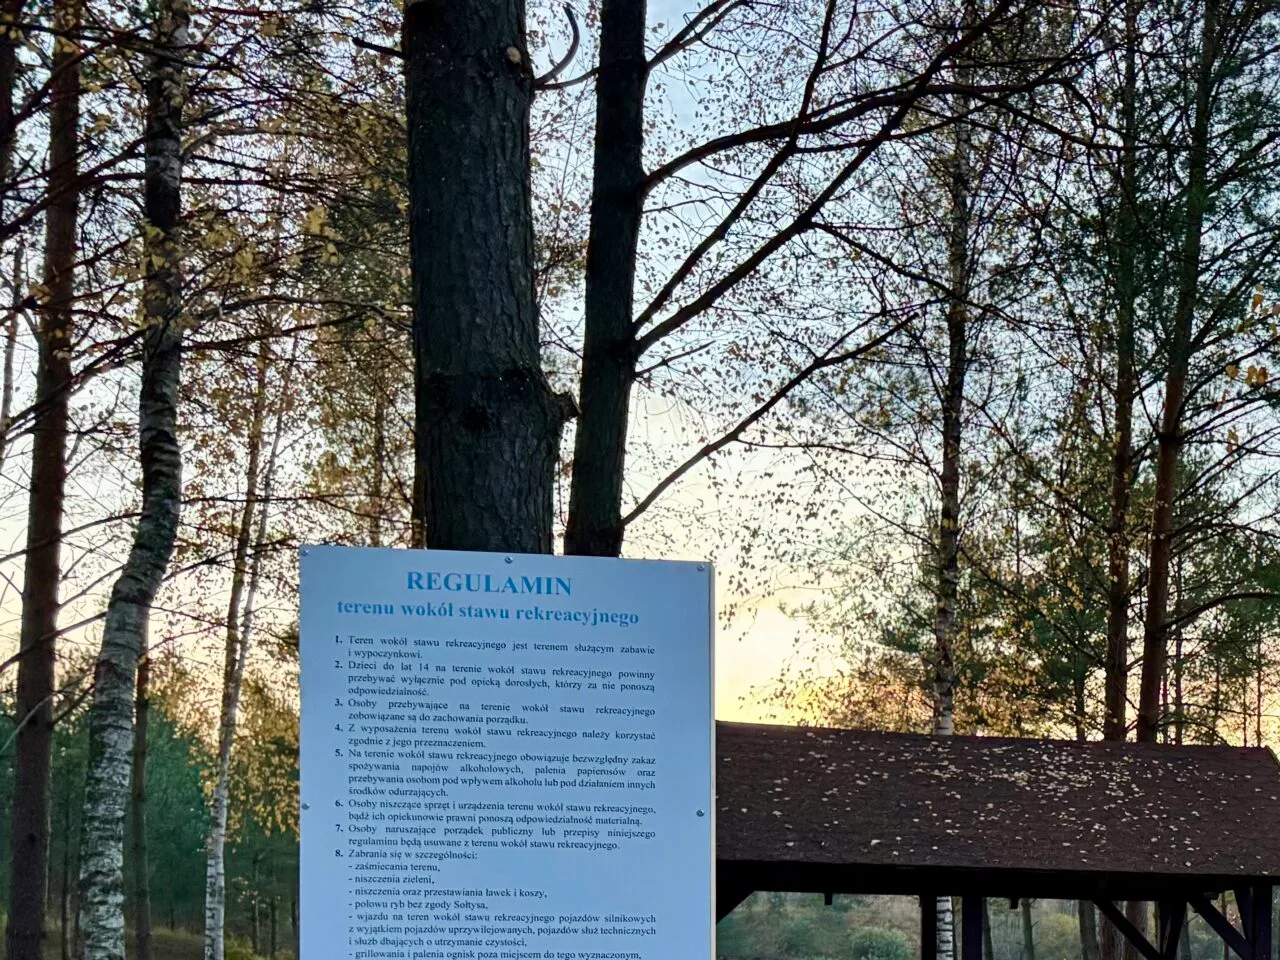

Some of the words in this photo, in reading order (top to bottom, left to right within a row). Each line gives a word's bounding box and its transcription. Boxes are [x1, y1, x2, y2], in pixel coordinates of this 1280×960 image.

[406, 571, 572, 596] REGULAMIN
[337, 600, 394, 615] terenu
[401, 602, 453, 617] wokół
[458, 605, 510, 620] stawu
[516, 606, 639, 627] rekreacyjnego
[335, 634, 343, 643] 1.
[347, 635, 373, 644] Teren
[379, 636, 407, 645] wokół
[413, 638, 439, 646] stawu
[445, 638, 506, 650] rekreacyjnego
[512, 641, 527, 651] jest
[533, 642, 568, 650] terenem
[574, 643, 614, 654] służącym
[620, 644, 655, 653] zabawie
[353, 648, 422, 660] wypoczynkowi.
[334, 660, 343, 668] 2.
[348, 660, 377, 669] Dzieci
[382, 661, 395, 669] do
[400, 662, 412, 670] lat
[419, 662, 429, 670] 14
[452, 663, 482, 672] terenie
[487, 664, 514, 673] wokół
[552, 667, 612, 678] rekreacyjnego
[618, 669, 655, 680] powinny
[347, 672, 396, 684] przebywać
[400, 674, 445, 685] wyłącznie
[449, 676, 466, 686] pod
[471, 676, 500, 687] opieką
[554, 679, 583, 690] którzy
[601, 680, 615, 689] nie
[620, 683, 655, 692] ponoszą
[347, 685, 429, 697] odpowiedzialność.
[334, 722, 343, 730] 4.
[360, 723, 417, 734] wyposażenia
[453, 725, 481, 734] wokół
[486, 727, 512, 735] stawu
[516, 727, 577, 739] rekreacyjnego
[581, 729, 610, 739] należy
[615, 730, 655, 741] korzystać
[347, 735, 383, 746] zgodnie
[392, 736, 412, 747] jego
[413, 737, 486, 749] przeznaczeniem.
[334, 798, 343, 806] 6.
[347, 798, 378, 809] Osoby
[379, 799, 421, 809] niszczące
[423, 800, 450, 810] sprzęt
[457, 800, 505, 810] urządzenia
[536, 802, 563, 810] wokół
[565, 803, 591, 811] stawu
[348, 810, 370, 820] bądź
[371, 811, 385, 819] ich
[387, 811, 443, 822] opiekunowie
[445, 812, 476, 823] prawni
[478, 815, 514, 823] ponoszą
[515, 814, 593, 825] odpowiedzialność
[595, 815, 643, 825] materialną.
[334, 848, 343, 856] 8.
[348, 848, 387, 857] Zabrania
[389, 849, 402, 858] się
[354, 861, 408, 869] zaśmiecania
[410, 863, 440, 871] terenu,
[354, 873, 400, 882] niszczenia
[402, 874, 435, 884] zieleni,
[354, 886, 400, 894] niszczenia
[423, 887, 483, 897] przestawiania
[485, 887, 511, 896] ławek
[519, 888, 547, 898] koszy,
[354, 898, 388, 909] połowu
[390, 899, 405, 909] ryb
[406, 899, 422, 907] bez
[424, 899, 452, 909] zgody
[453, 899, 488, 910] Sołtysa,
[356, 911, 388, 921] wjazdu
[433, 912, 460, 920] wokół
[493, 912, 555, 923] rekreacyjnego
[558, 913, 600, 923] pojazdów
[604, 913, 656, 924] silnikowych
[356, 923, 402, 934] wyjątkiem
[403, 924, 446, 934] pojazdów
[537, 925, 579, 935] pojazdów
[600, 926, 656, 936] technicznych
[379, 936, 424, 946] dbających
[434, 937, 483, 947] utrzymanie
